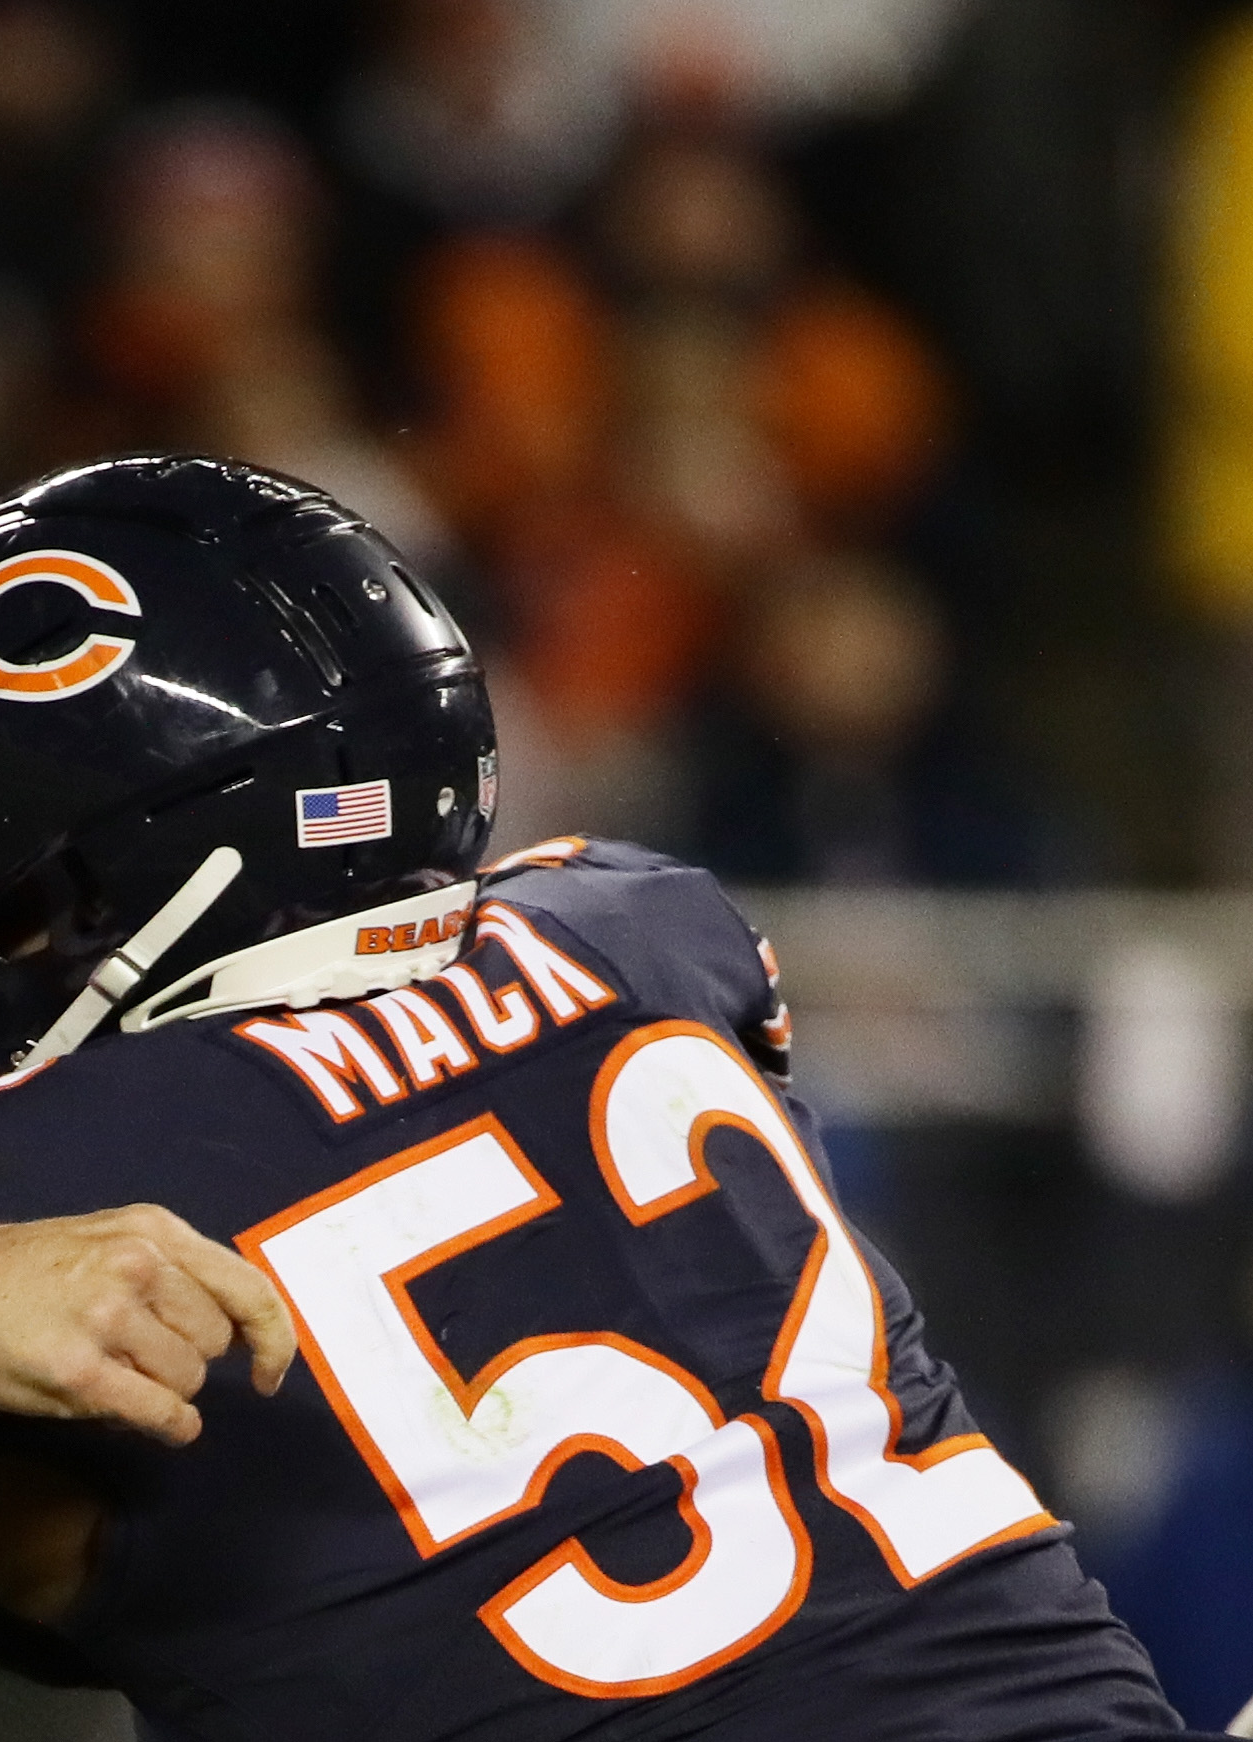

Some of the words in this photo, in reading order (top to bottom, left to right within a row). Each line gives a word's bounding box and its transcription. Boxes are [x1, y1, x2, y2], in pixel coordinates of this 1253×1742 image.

[231, 899, 617, 1123] MACK
[355, 901, 474, 955] BEAR
[232, 1019, 1061, 1699] 52
